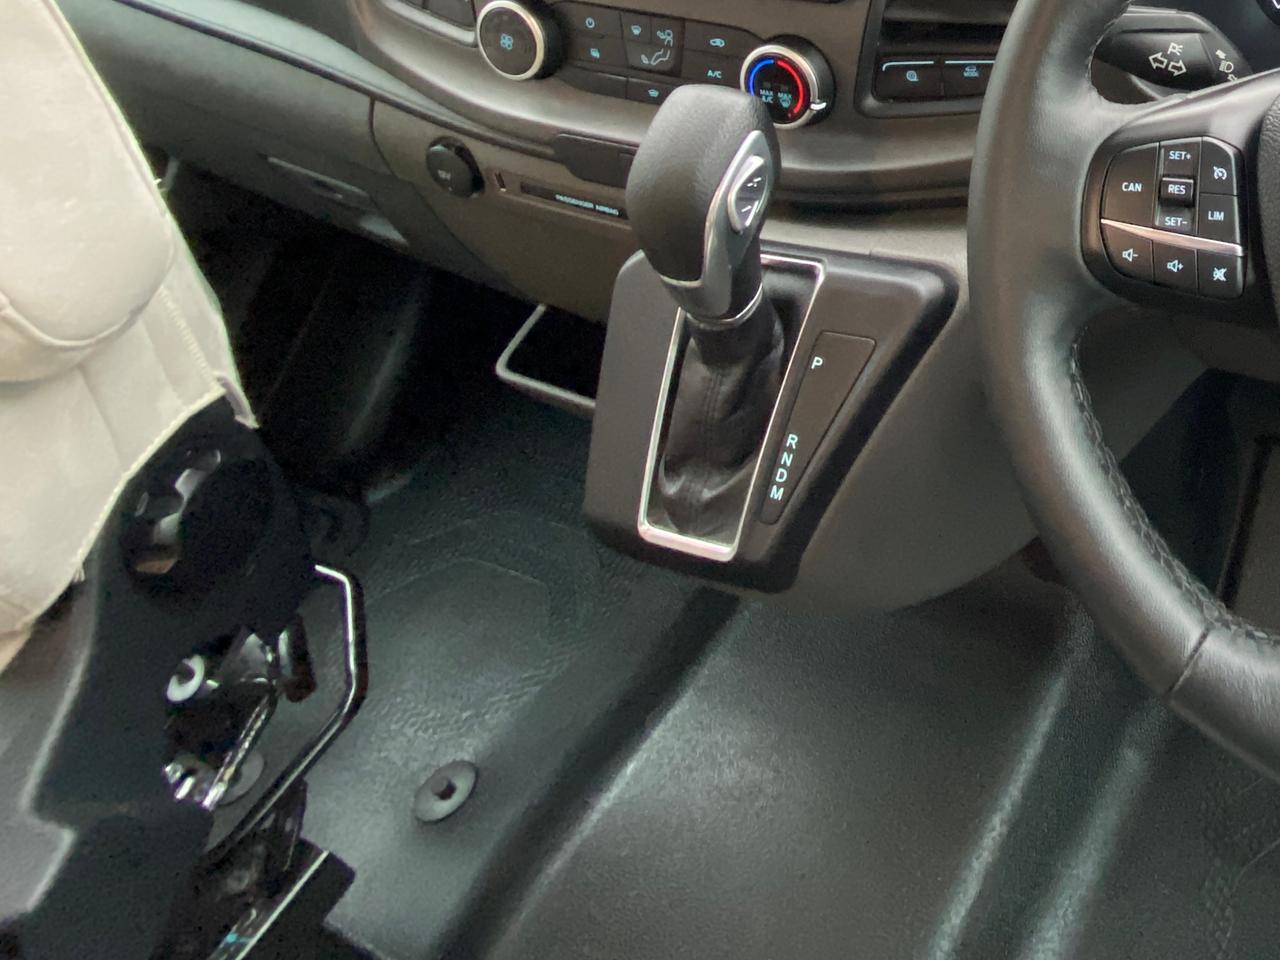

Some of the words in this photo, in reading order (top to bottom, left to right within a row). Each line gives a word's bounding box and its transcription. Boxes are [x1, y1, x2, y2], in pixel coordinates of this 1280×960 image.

[707, 69, 722, 79] A/C
[1169, 150, 1191, 161] SET+
[1121, 181, 1142, 193] CAN
[1167, 184, 1186, 195] RES
[1207, 210, 1224, 221] LIM
[811, 356, 823, 370] P
[786, 434, 798, 449] R
[781, 452, 793, 467] N
[775, 468, 787, 482] D
[770, 485, 784, 501] M
